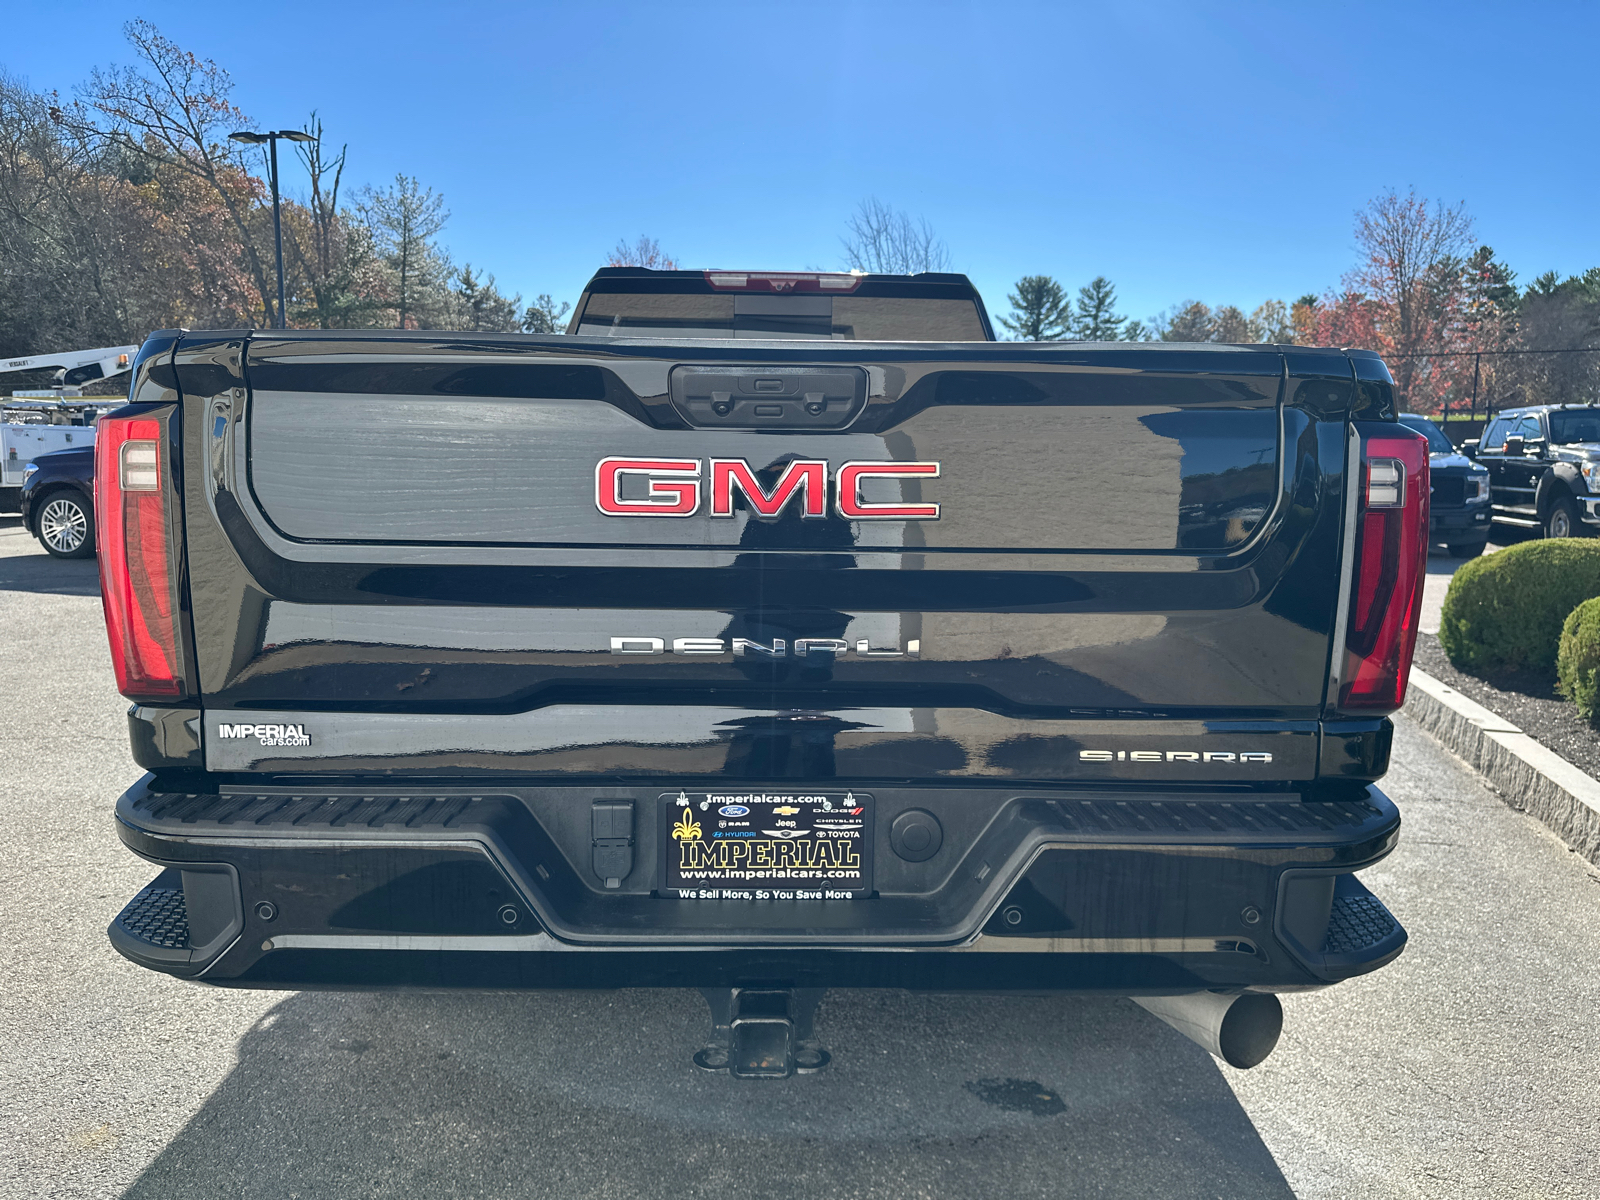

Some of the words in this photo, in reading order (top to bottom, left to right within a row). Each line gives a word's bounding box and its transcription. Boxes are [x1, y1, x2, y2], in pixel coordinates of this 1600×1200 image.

[595, 456, 941, 520] GMC
[610, 637, 920, 656] DENALI
[219, 724, 310, 738] IMPERIAL
[260, 737, 311, 746] cars.com
[1079, 750, 1273, 763] SIERRA
[706, 794, 826, 806] Imperialcars.com
[775, 819, 796, 828] Jeep
[828, 830, 860, 838] TOYOTA
[680, 840, 859, 868] IMPERIAL
[680, 868, 860, 880] www.imperialcars.com
[679, 890, 697, 899] We
[699, 889, 720, 899] Sell
[722, 889, 753, 900] More,
[756, 890, 770, 899] So
[773, 890, 794, 899] You
[796, 890, 822, 899] Save
[825, 889, 852, 899] More
